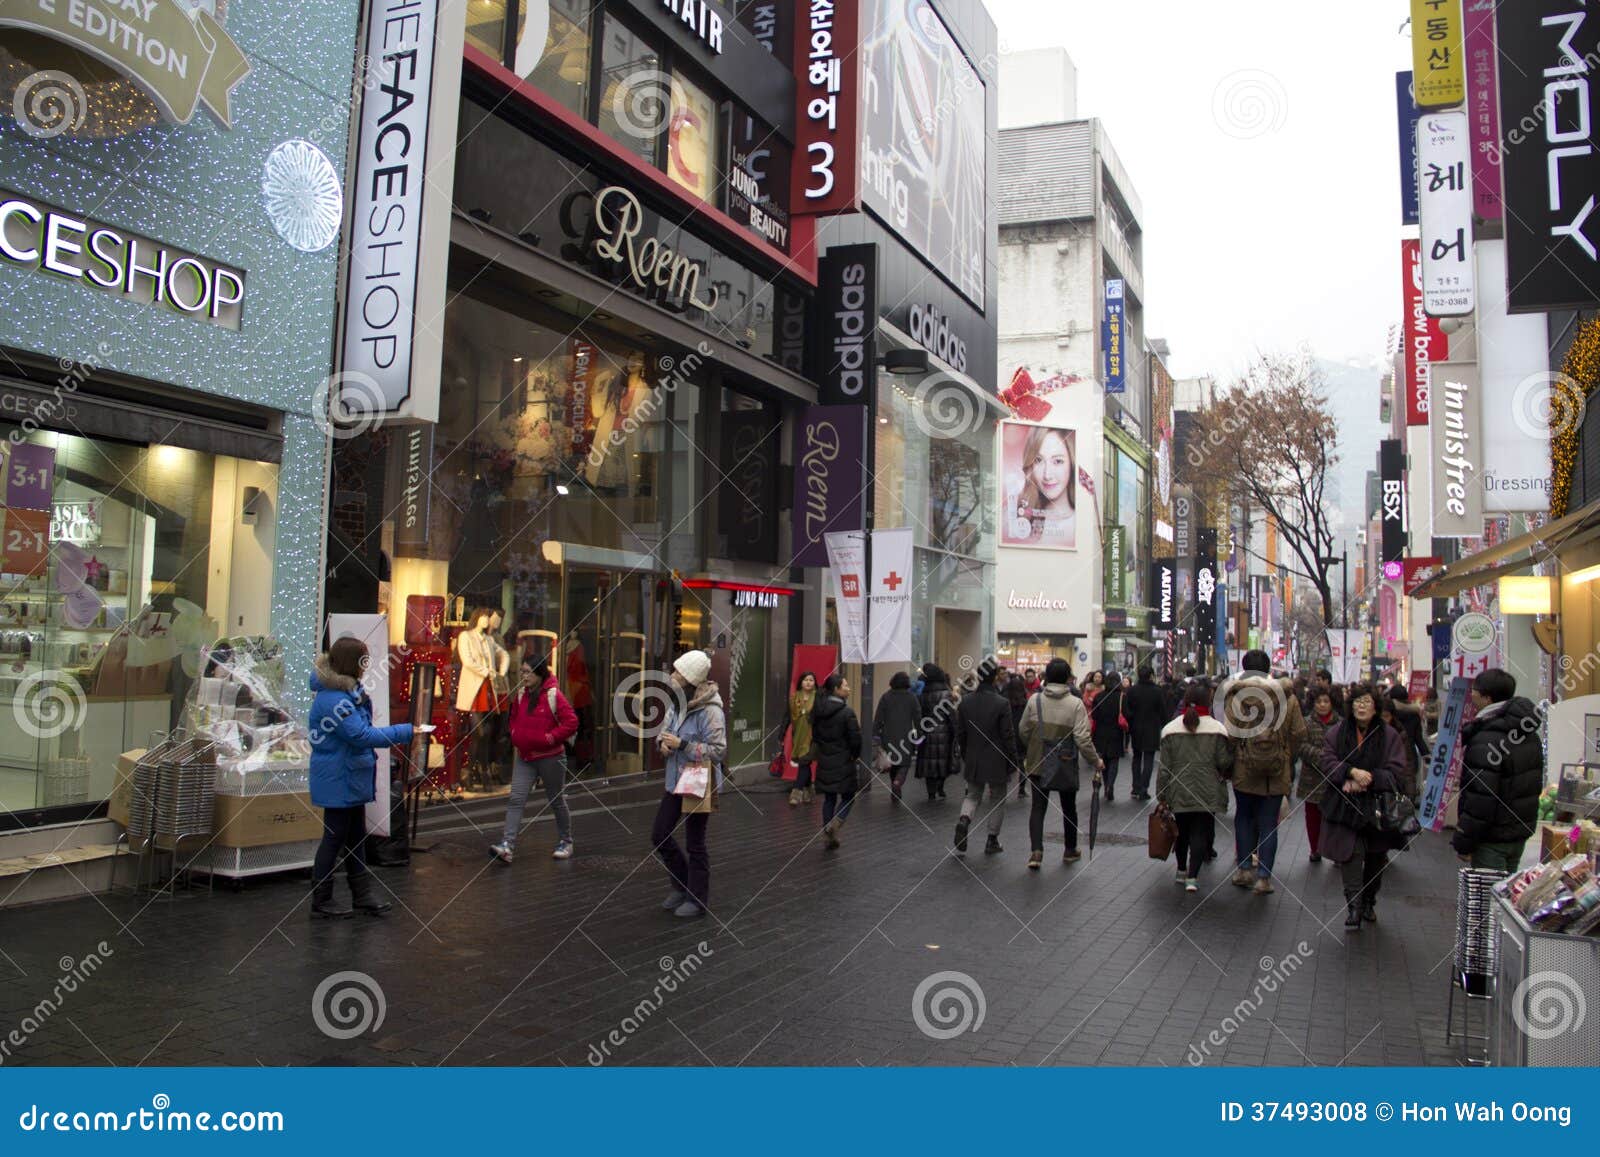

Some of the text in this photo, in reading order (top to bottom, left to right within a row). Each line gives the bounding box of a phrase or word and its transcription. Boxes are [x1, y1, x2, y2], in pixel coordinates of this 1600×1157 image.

[69, 2, 187, 79] EDITION
[1541, 10, 1597, 262] MOLY
[731, 166, 759, 202] JUNO
[750, 204, 787, 247] BEAUTY
[1424, 161, 1465, 262] 헤어
[0, 200, 244, 318] CESHOP
[595, 186, 718, 312] Roem
[834, 263, 865, 396] adidas
[910, 303, 967, 373] adidas
[1413, 295, 1431, 412] new balance
[1442, 381, 1473, 516] innisfree
[12, 465, 48, 489] 3+1
[801, 421, 839, 544] Roem
[1484, 475, 1552, 495] Dressing
[1383, 480, 1400, 521] BSX
[7, 530, 43, 552] 2+1
[1112, 528, 1120, 560] NATURE
[1177, 521, 1189, 558] FUBU
[735, 590, 779, 608] JUNO HAIR
[1008, 588, 1050, 609] banila
[1455, 655, 1488, 678] 1+1
